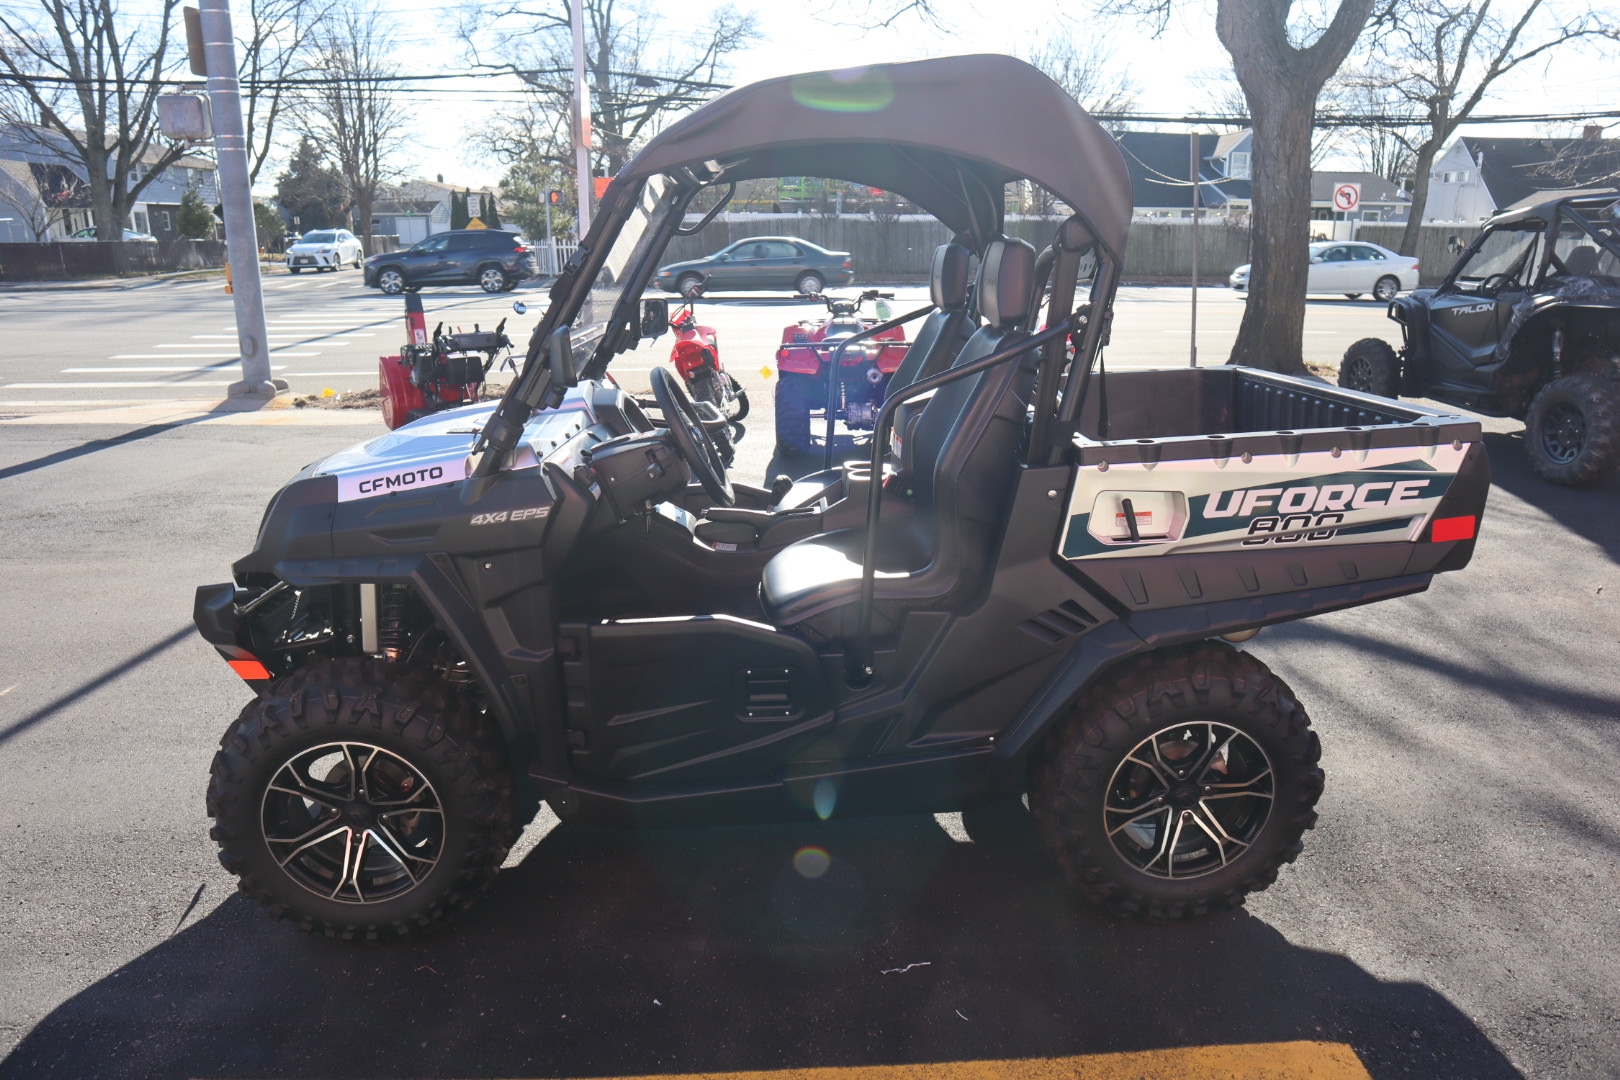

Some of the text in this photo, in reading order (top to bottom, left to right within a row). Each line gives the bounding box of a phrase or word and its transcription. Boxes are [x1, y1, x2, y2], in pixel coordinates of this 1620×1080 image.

[469, 208, 480, 216] 30
[1451, 302, 1496, 316] TALON
[359, 466, 443, 494] CFMOTO
[1202, 479, 1430, 519] UFORCE
[470, 506, 550, 526] 4X4 EPS
[1241, 513, 1345, 547] 800
